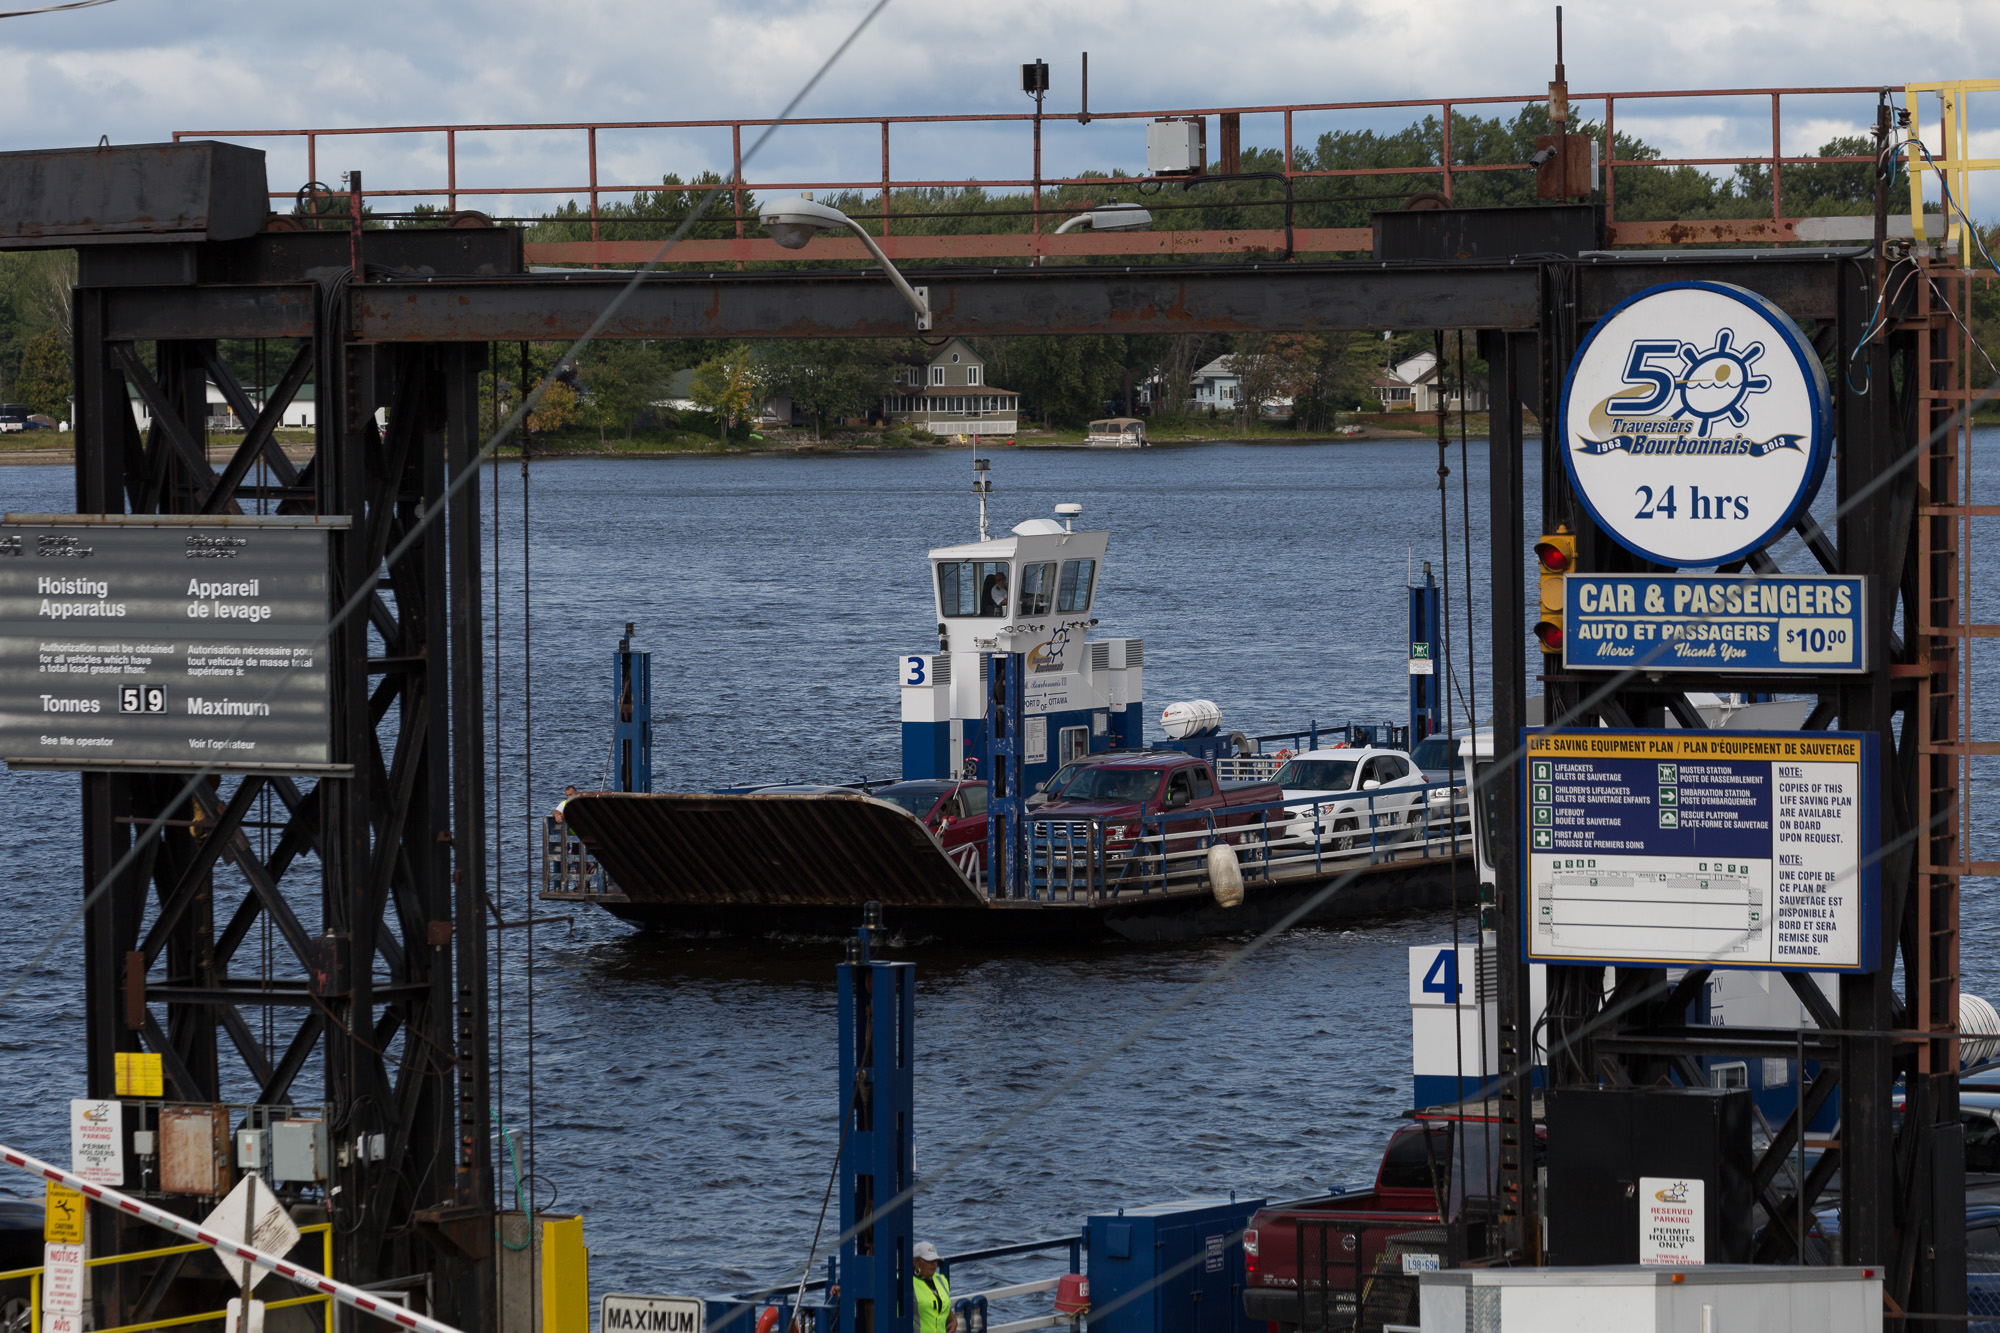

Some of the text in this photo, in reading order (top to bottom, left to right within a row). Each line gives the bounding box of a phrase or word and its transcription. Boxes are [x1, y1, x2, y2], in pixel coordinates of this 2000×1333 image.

[1611, 418, 1694, 434] Traversiers
[1597, 439, 1621, 452] 1963
[1628, 433, 1751, 456] Bourbonnais
[1762, 437, 1786, 453] 2013
[1634, 485, 1749, 520] 24 hrs
[38, 577, 108, 598] Hoisting
[187, 578, 259, 598] Appareil
[1580, 584, 1852, 614] CAR & PASSENGERS
[39, 599, 126, 620] Apparatus
[188, 601, 272, 622] de levage
[1578, 624, 1770, 642] AUTO ET PASSAGERS
[1786, 628, 1846, 652] $10.00
[40, 643, 174, 654] Authorization must be obtained
[187, 645, 240, 655] Autorisation
[242, 646, 291, 656] nécessaire
[1596, 642, 1634, 656] Merci
[1674, 642, 1747, 662] Thank You
[40, 654, 152, 664] for all vehicles which have
[188, 656, 206, 666] tout
[246, 658, 258, 666] de
[260, 658, 289, 667] masse
[48, 664, 67, 672] total
[69, 664, 88, 673] load
[90, 665, 122, 674] greater
[188, 666, 234, 676] supérieure
[907, 657, 925, 685] 3
[40, 695, 100, 712] Tonnes
[188, 698, 270, 716] Maximum
[40, 736, 114, 748] See the operator
[189, 739, 206, 748] Voir
[1531, 738, 1856, 755] LIFE SAVING EQUIPMENT PLAN PLAN D'ÉQUIPEMENT DE SAUVETAGE
[1554, 764, 1594, 772] LIFEJACKETS
[1680, 766, 1732, 774] MUSTER STATION
[1779, 767, 1802, 777] NOTE:
[1680, 775, 1700, 783] POSTE
[1710, 776, 1763, 784] RASSEMBLEMENT
[1556, 786, 1630, 795] CHILDREN'S LIFEJACKETS
[1680, 788, 1750, 797] EMBARKATION STATION
[1780, 783, 1842, 794] COPIES OF THIS
[1624, 796, 1650, 804] ENFANTS
[1680, 797, 1756, 806] POSTE D'EMBARQUEMENT
[1780, 796, 1852, 806] LIFE SAVING PLAN
[1556, 808, 1584, 816] LIFEBUOY
[1680, 811, 1738, 820] RESCUE PLATFORM
[1780, 808, 1841, 818] ARE AVAILABLE
[1680, 820, 1768, 829] PLATE-FORME DE SAUVETAGE
[1780, 820, 1820, 830] ON BOARD
[1780, 833, 1843, 844] UPON REQUEST.
[1584, 840, 1592, 848] DE
[1594, 840, 1624, 848] PREMIERS
[1626, 841, 1644, 849] SOINS
[1780, 854, 1802, 865] NOTE:
[1780, 871, 1836, 881] UNE COPIE DE
[1780, 883, 1826, 893] CE PLAN DE
[1780, 896, 1843, 906] SAUVETAGE EST
[1779, 907, 1834, 918] DISPONIBLE À
[1779, 921, 1836, 931] BORD ET SERA
[1779, 933, 1828, 943] REMISE SUR
[1778, 946, 1820, 956] DEMANDE.
[1423, 949, 1462, 1004] 4
[1650, 1208, 1693, 1216] RESERVED
[1650, 1234, 1695, 1242] HOLDERS
[50, 1250, 78, 1263] NOTICE
[608, 1308, 694, 1333] MAXIMUM
